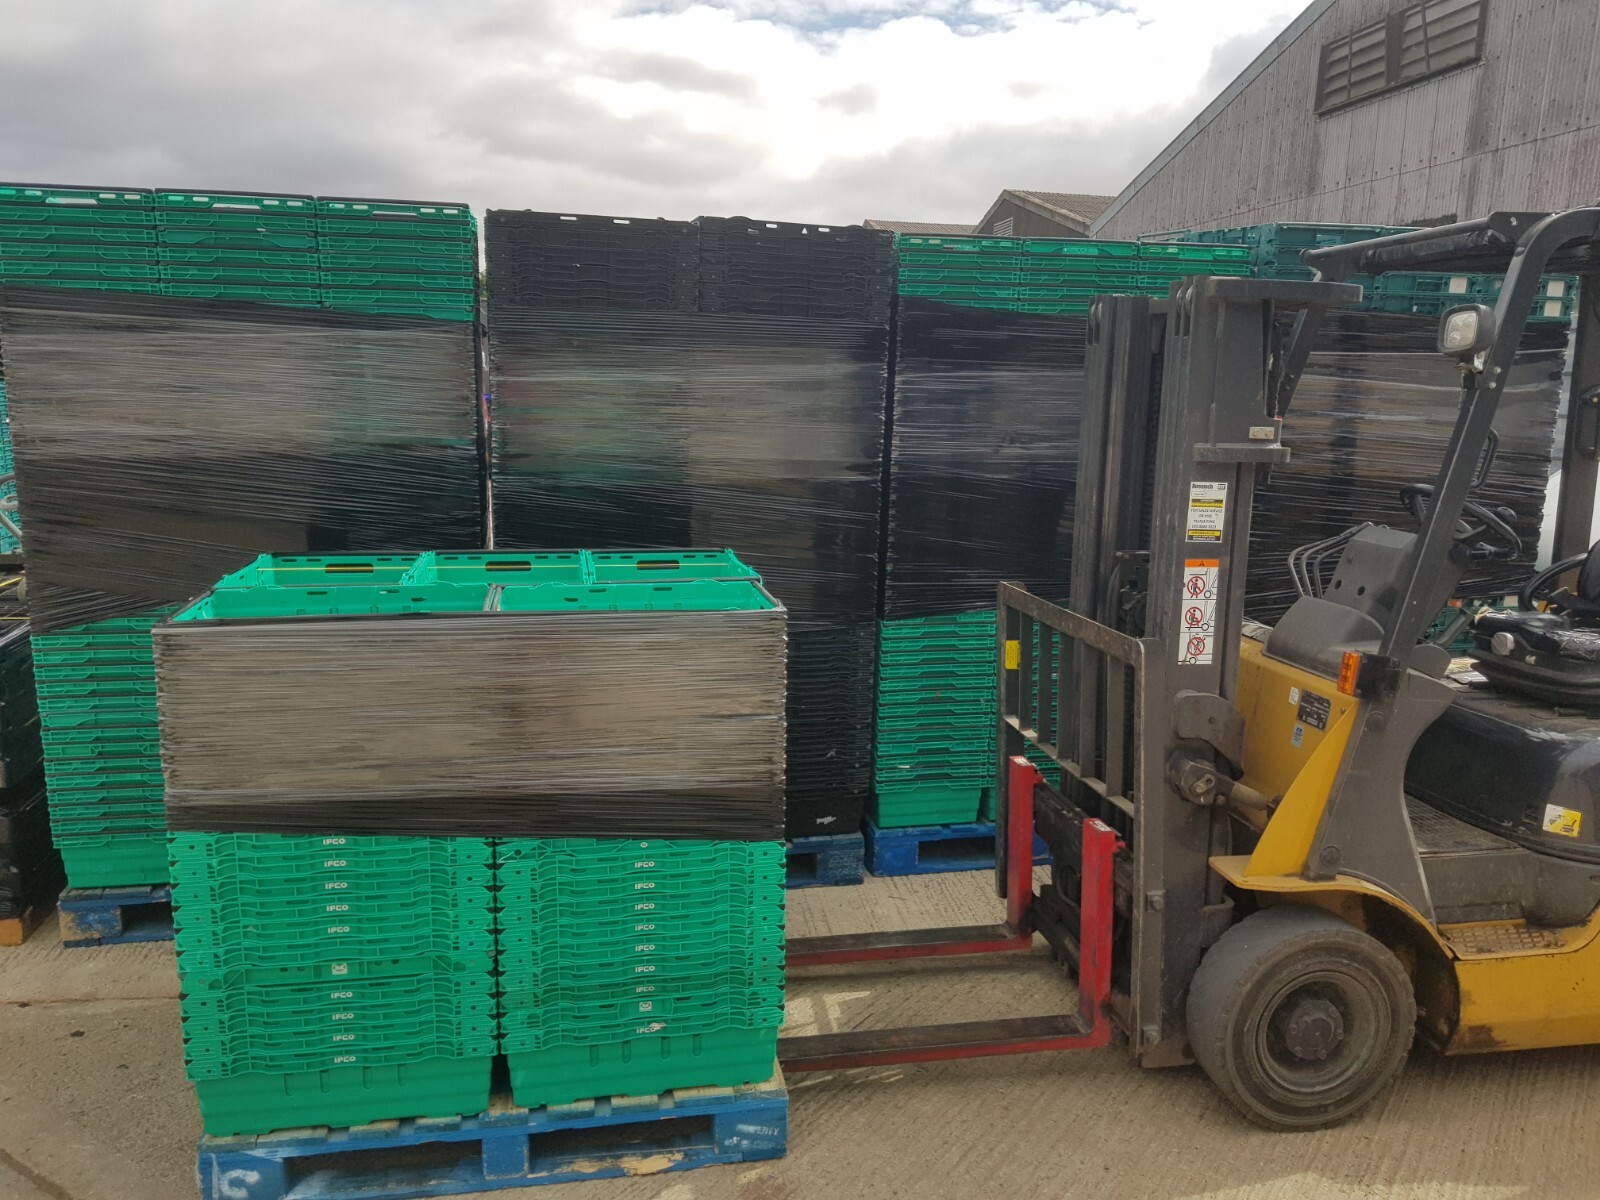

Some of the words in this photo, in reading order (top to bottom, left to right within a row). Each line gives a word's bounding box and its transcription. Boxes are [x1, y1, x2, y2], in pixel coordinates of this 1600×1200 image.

[324, 860, 347, 868] IFCO
[634, 882, 655, 890] IFCO
[635, 944, 656, 952] IFCO
[635, 965, 655, 973] IFCO
